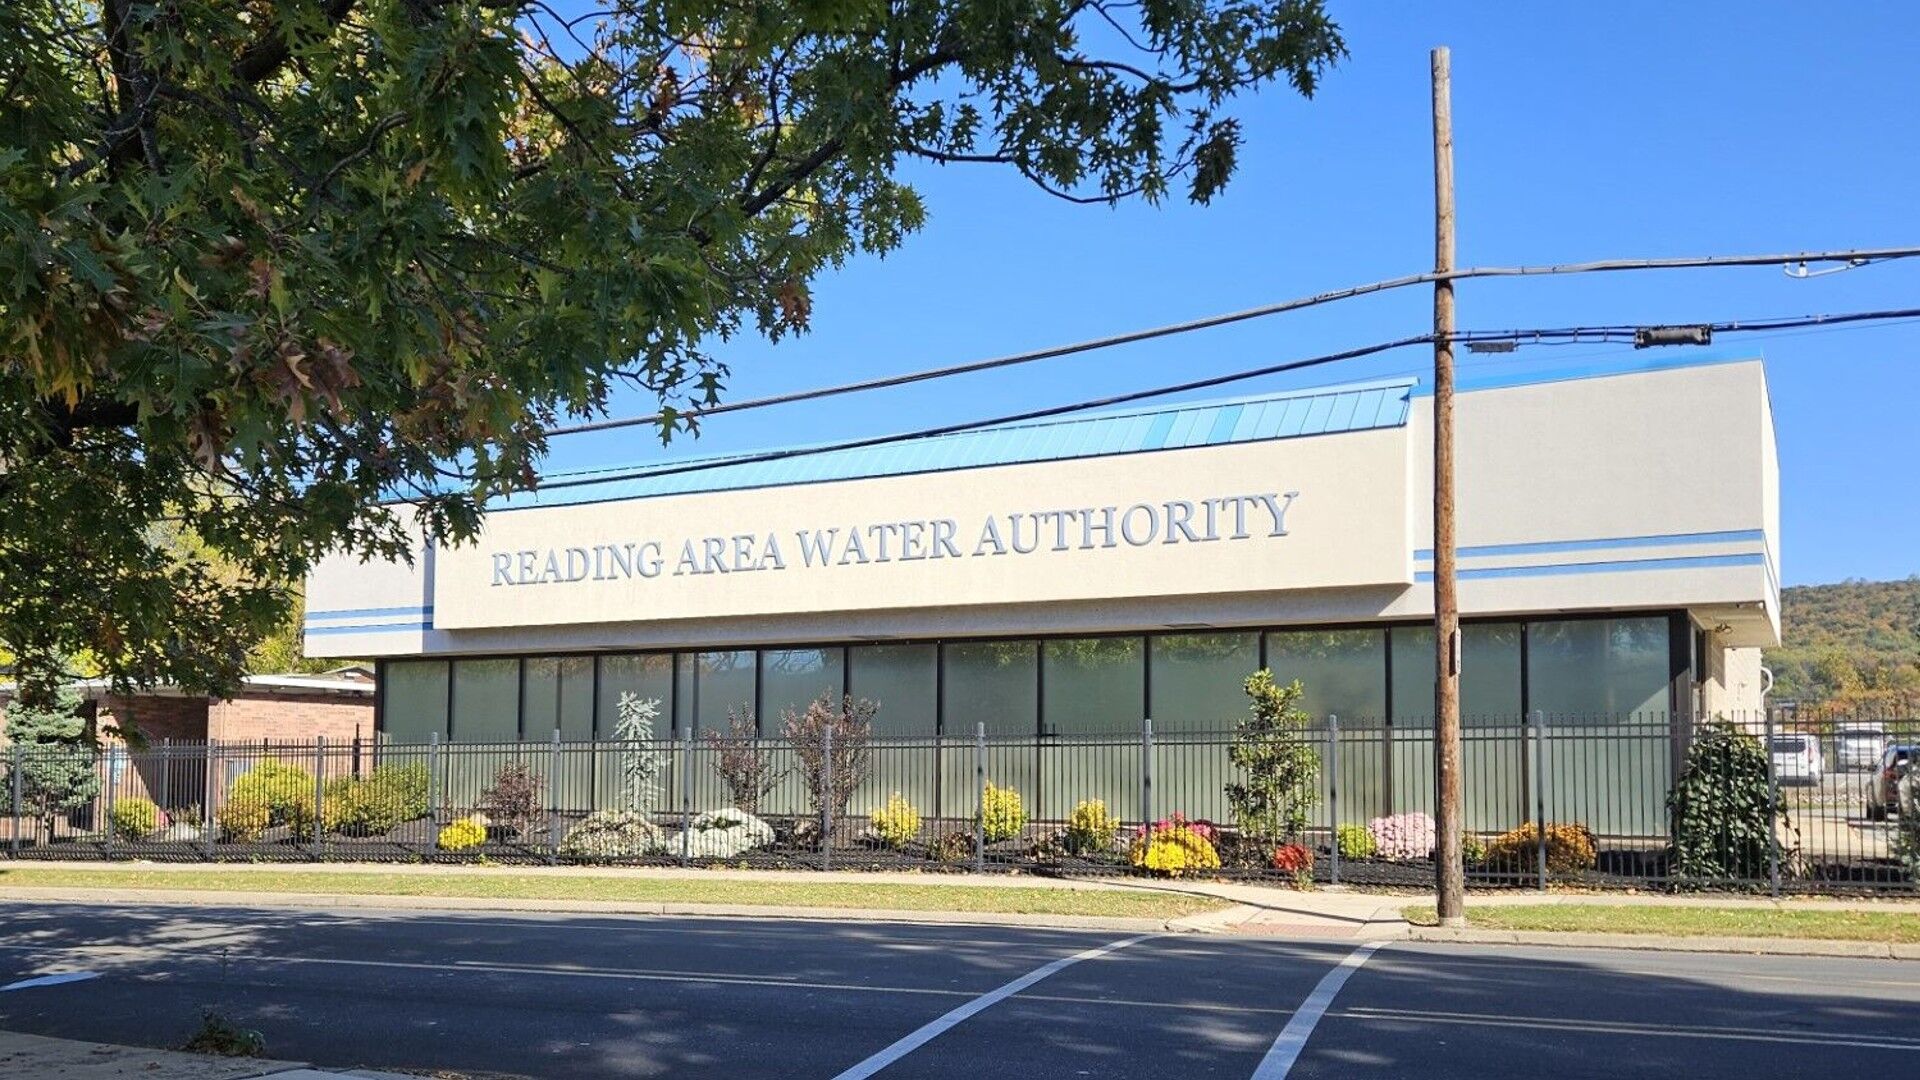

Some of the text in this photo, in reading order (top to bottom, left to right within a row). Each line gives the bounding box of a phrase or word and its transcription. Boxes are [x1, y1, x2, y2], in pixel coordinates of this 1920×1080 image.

[490, 491, 1299, 587] READING AREA WATER AUTHORITY
